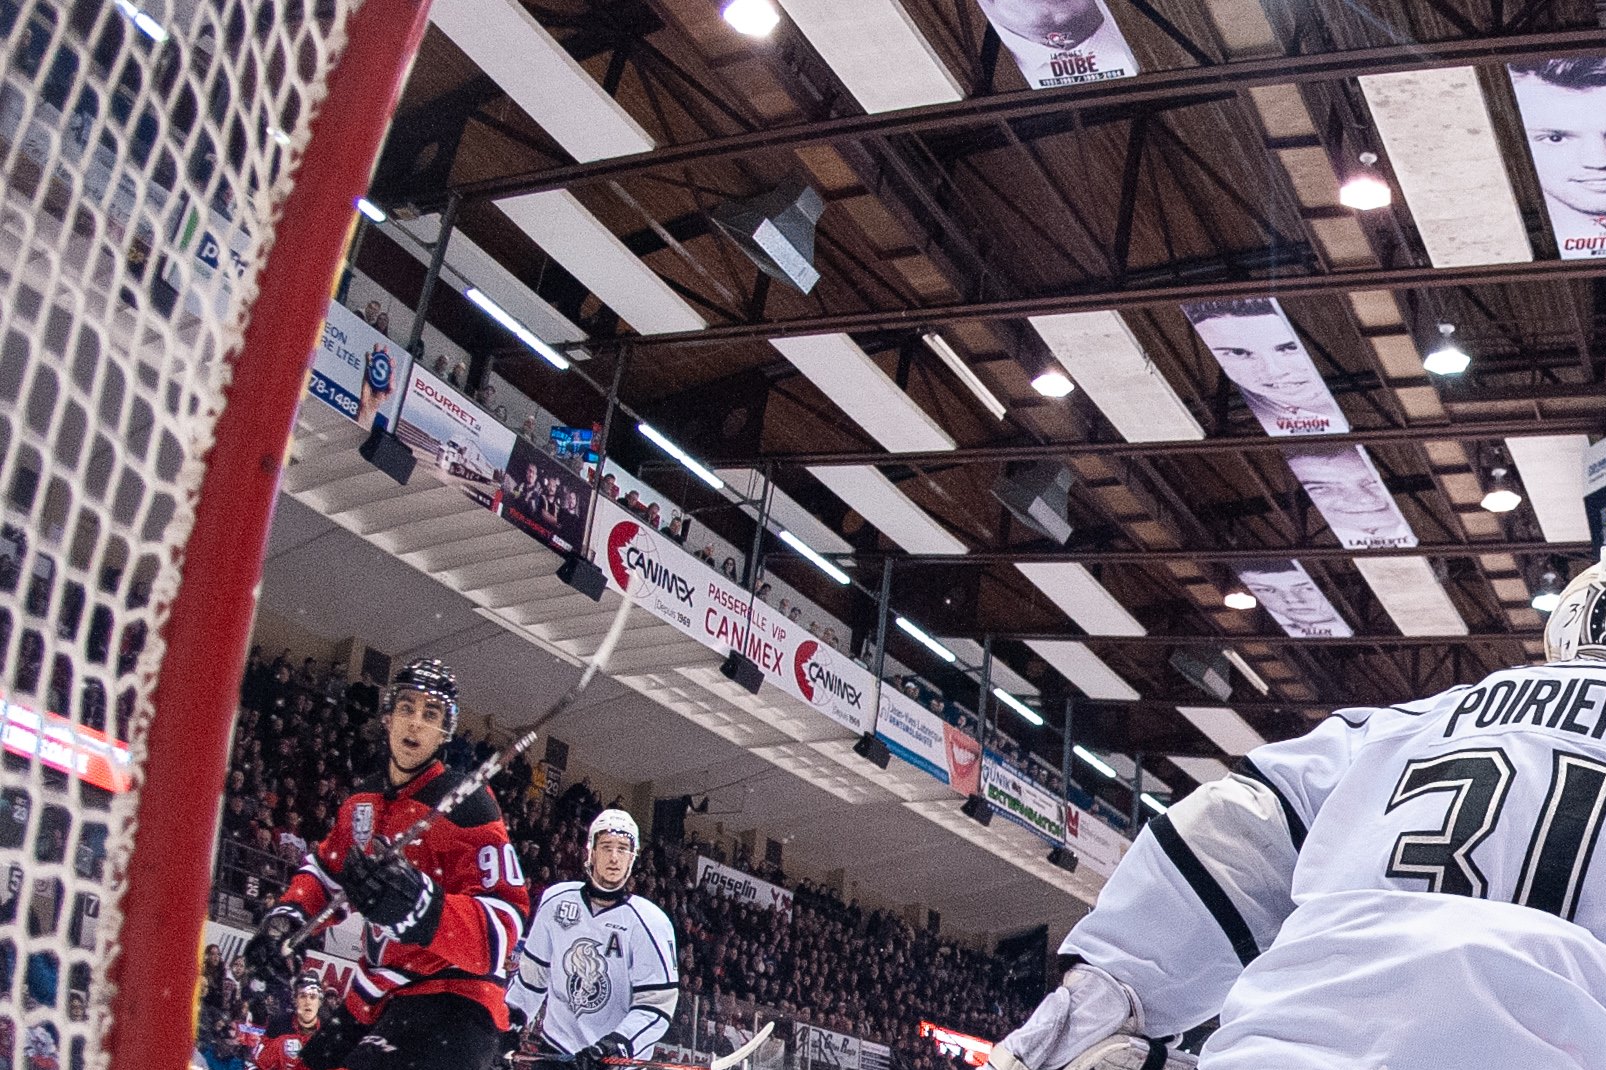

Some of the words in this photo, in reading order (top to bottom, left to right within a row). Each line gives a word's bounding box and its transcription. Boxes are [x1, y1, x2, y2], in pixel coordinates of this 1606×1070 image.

[415, 377, 477, 426] BOURRET
[626, 546, 696, 608] CANIMEX
[705, 607, 784, 676] CANMEX
[771, 623, 787, 643] VIP
[808, 662, 862, 710] CANIMEX
[477, 842, 526, 889] 90
[700, 864, 758, 900] Gosselin
[560, 902, 577, 918] 50
[604, 922, 628, 932] CCM
[605, 931, 624, 959] A
